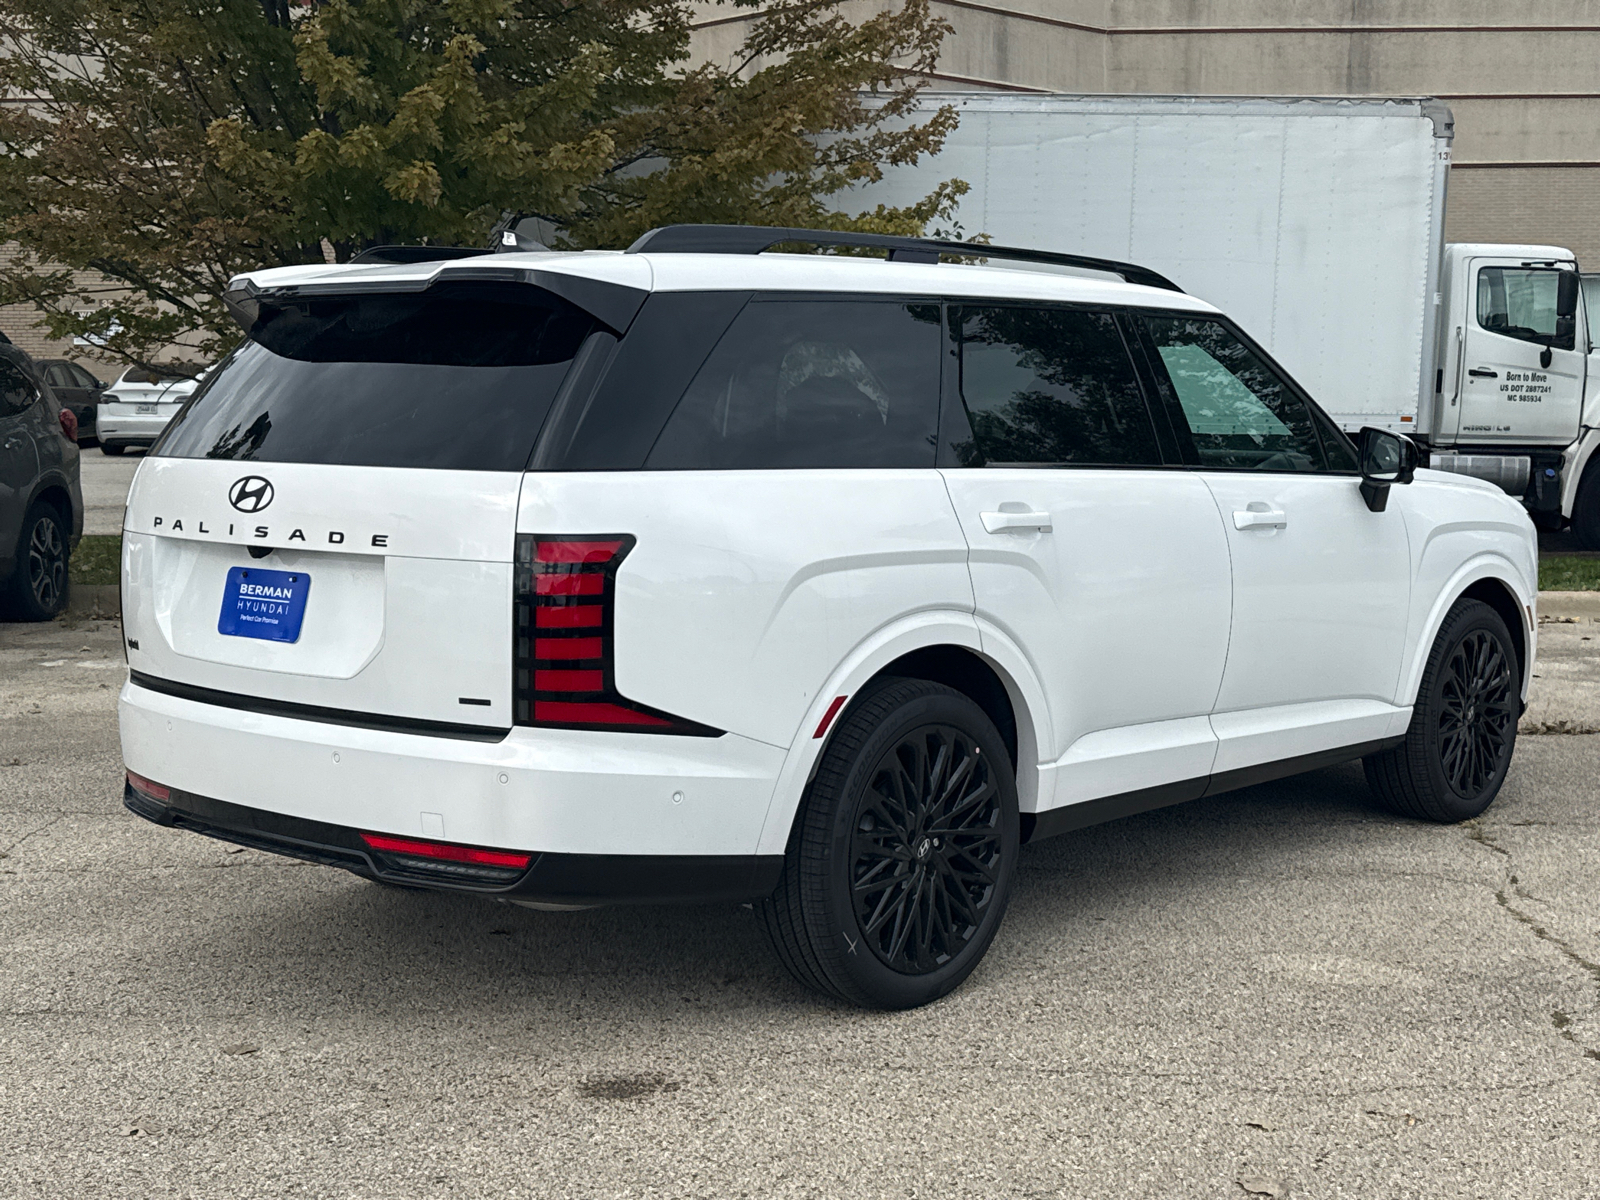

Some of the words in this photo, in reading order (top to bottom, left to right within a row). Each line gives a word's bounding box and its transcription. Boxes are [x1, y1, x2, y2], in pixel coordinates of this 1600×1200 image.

[1506, 371, 1521, 381] Born
[1523, 373, 1529, 382] to
[1531, 372, 1547, 382] Move
[1500, 384, 1509, 392] US
[1510, 384, 1524, 392] DOT
[153, 516, 389, 548] PALISADE
[240, 583, 292, 598] BERMAN
[237, 600, 288, 615] HYUNDAI
